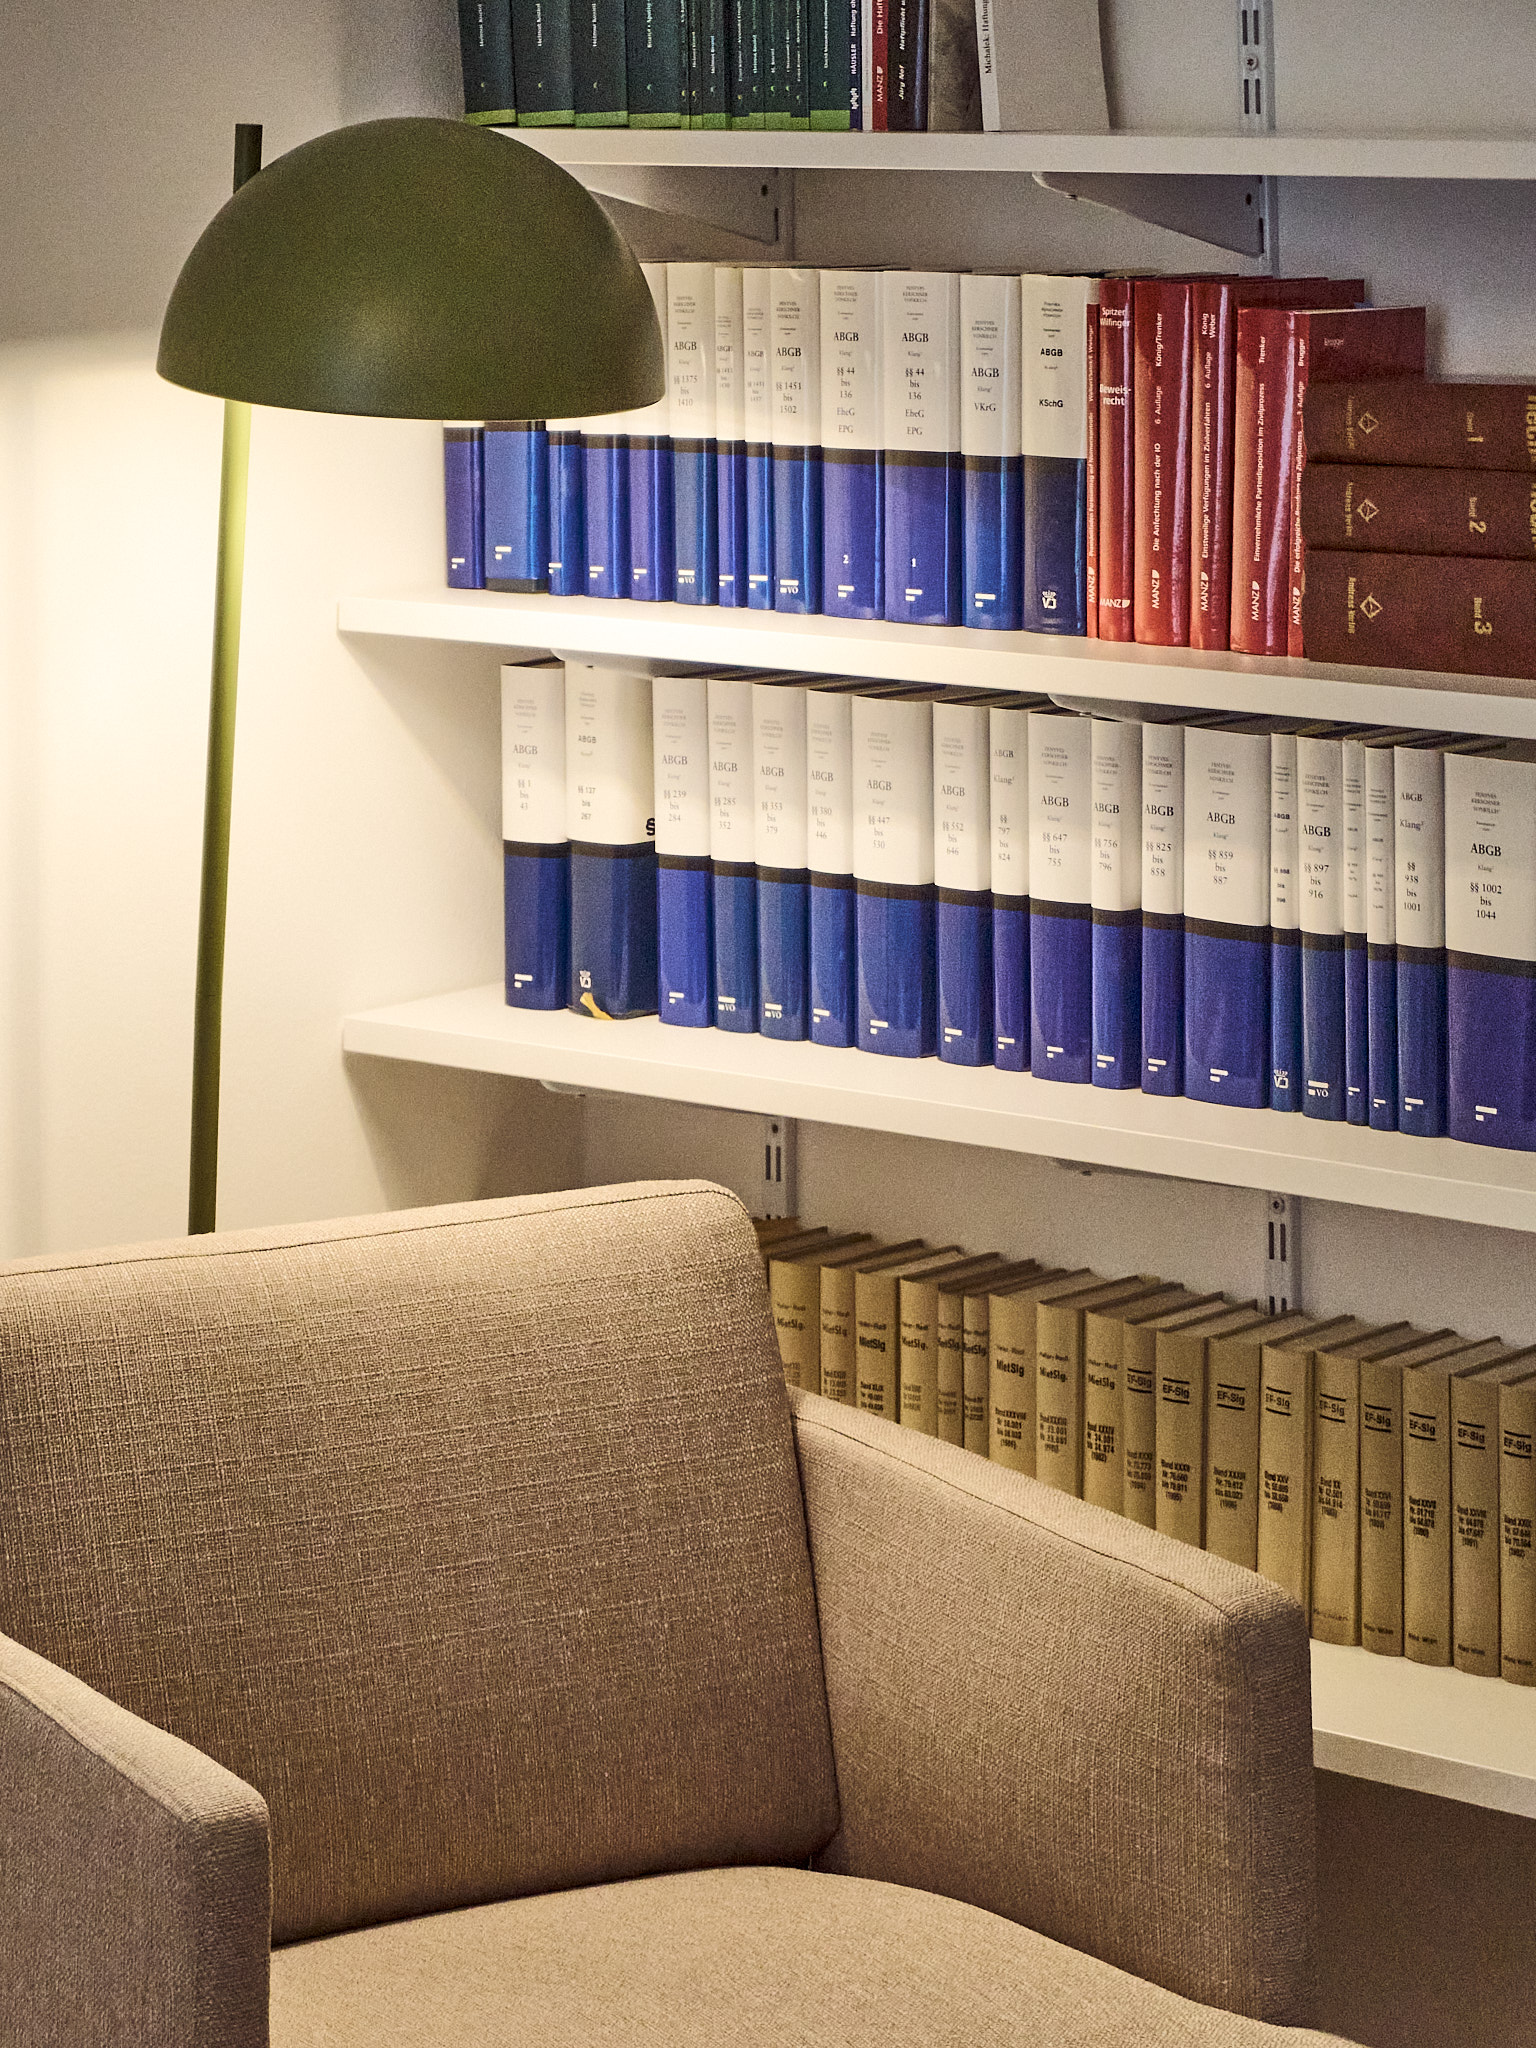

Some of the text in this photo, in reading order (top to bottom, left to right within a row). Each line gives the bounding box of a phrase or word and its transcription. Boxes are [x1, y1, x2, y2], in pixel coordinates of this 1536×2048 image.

[1201, 313, 1209, 335] König
[834, 331, 859, 342] ABGB
[901, 332, 929, 343] ABGB
[1155, 313, 1164, 367] König/Trenker
[674, 341, 697, 351] ABGB
[776, 347, 801, 357] ABGB
[1040, 348, 1063, 357] ABGB
[1297, 338, 1305, 367] Brugger
[915, 368, 925, 376] 44
[971, 367, 999, 378] ABGB
[974, 403, 997, 412] VKrG
[1039, 399, 1064, 408] KSchG
[1102, 396, 1125, 406] recht
[1467, 435, 1484, 443] 1
[1203, 454, 1210, 463] im
[1203, 465, 1211, 513] Verfügungen
[1253, 501, 1262, 562] Einvernehmliche
[1258, 426, 1264, 436] im
[1153, 491, 1162, 537] Anfechtung
[1469, 520, 1487, 534] 2
[1202, 514, 1211, 559] Einstweilige
[842, 554, 849, 564] 2
[911, 558, 917, 568] 1
[1152, 578, 1160, 609] MANZ
[1201, 580, 1209, 611] MANZ
[1251, 589, 1260, 621] MANZ
[1292, 595, 1301, 625] MANZ
[1474, 621, 1493, 635] 3
[993, 749, 1014, 758] ABGB
[1041, 795, 1069, 808] ABGB
[1400, 792, 1423, 802] ABGB
[1094, 802, 1120, 814] ABGB
[1144, 804, 1174, 817] ABGB
[1206, 811, 1236, 825] ABGB
[1302, 824, 1331, 837] ABGB
[1470, 843, 1502, 857] ABGB
[1481, 883, 1503, 895] 1002
[1480, 896, 1492, 907] bis
[1476, 909, 1496, 920] 1044
[1162, 1384, 1190, 1399] EF-Slg
[1216, 1391, 1245, 1406] EF-Slg
[1364, 1413, 1392, 1428] EF-Slg
[1409, 1419, 1436, 1436] EF-Slg
[1457, 1428, 1485, 1444] EF-Slg
[1503, 1437, 1532, 1453] EF-Slg
